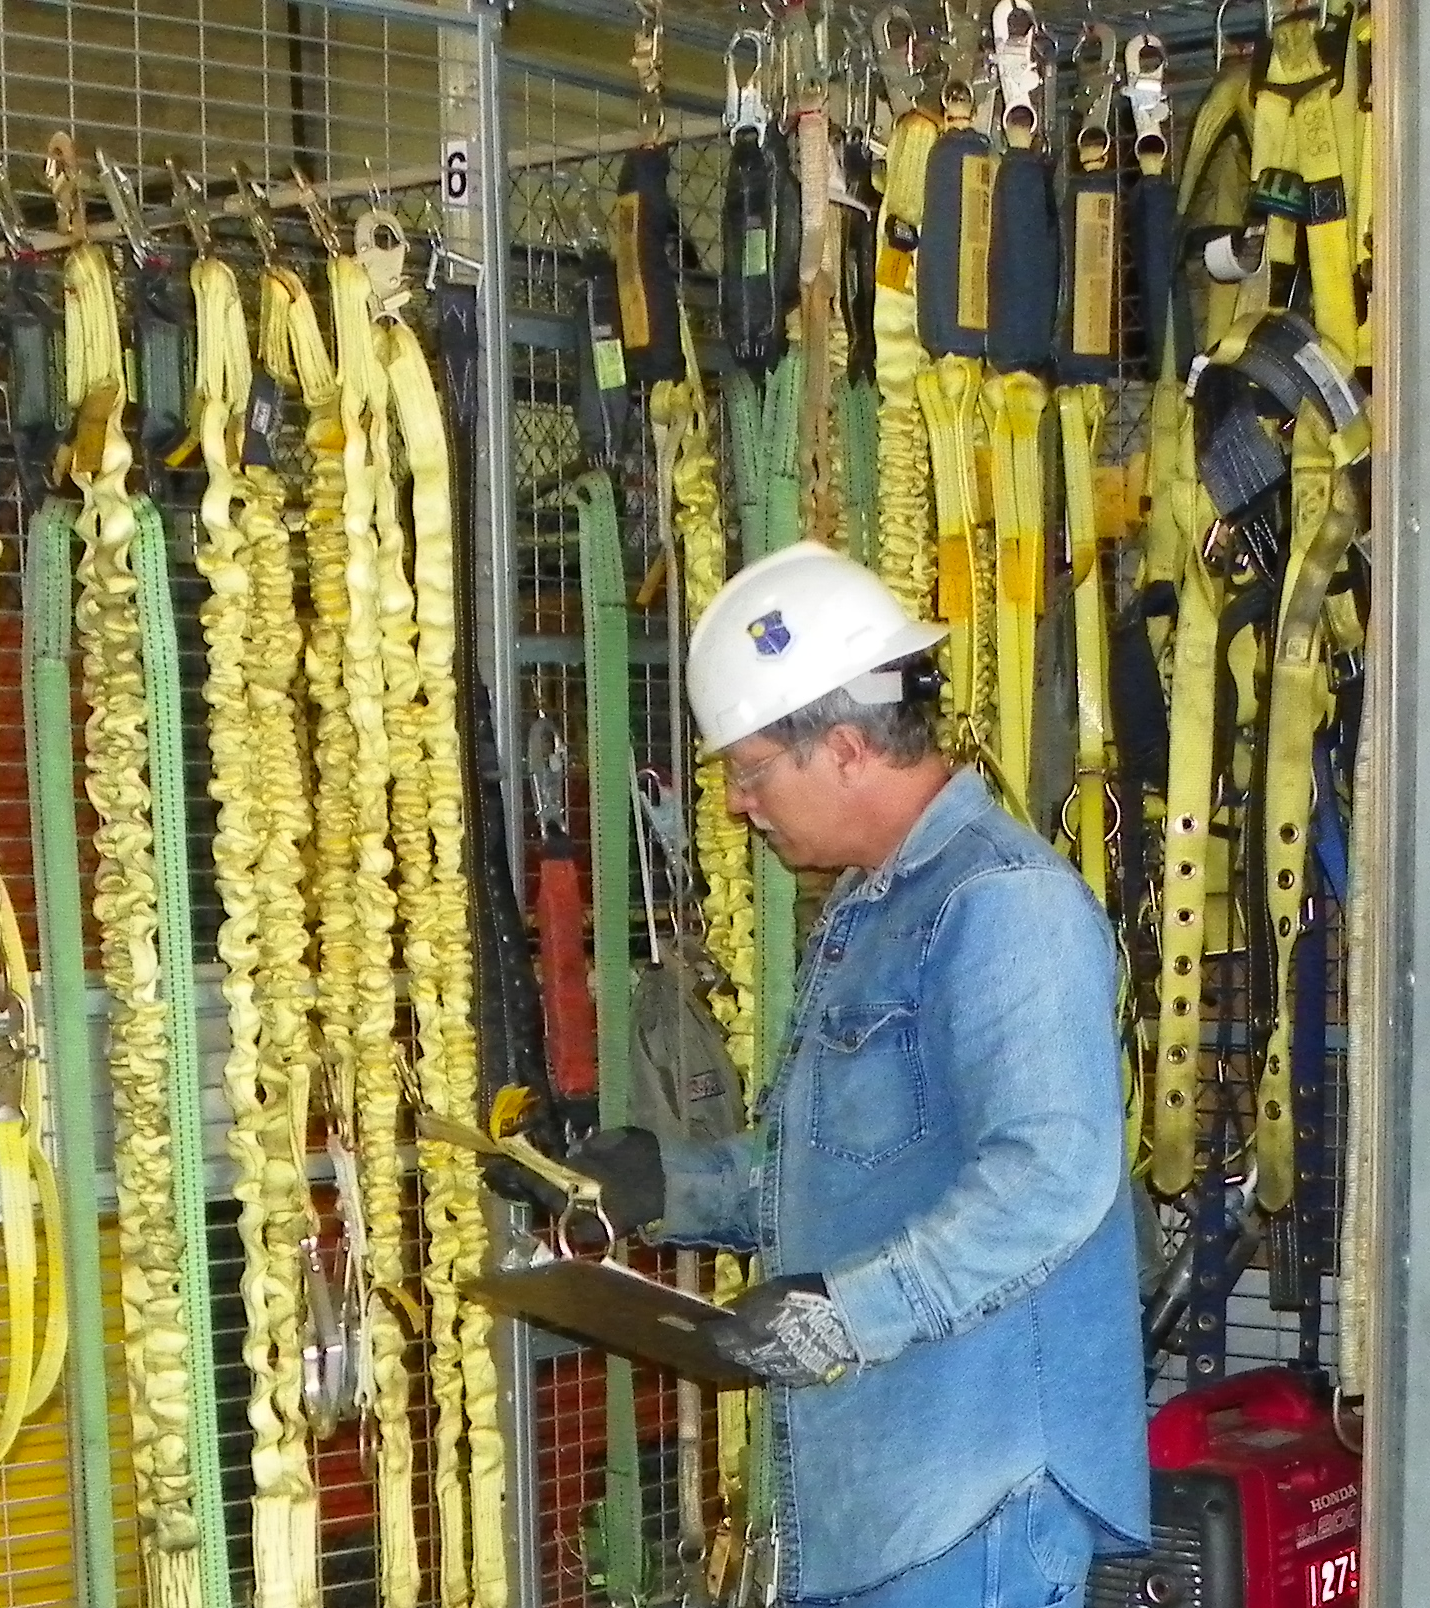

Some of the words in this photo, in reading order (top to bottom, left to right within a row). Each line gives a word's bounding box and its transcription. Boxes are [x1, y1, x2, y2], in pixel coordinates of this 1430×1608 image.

[448, 152, 467, 198] 6
[1309, 1484, 1358, 1513] HONDA
[1310, 1550, 1357, 1607] 127
